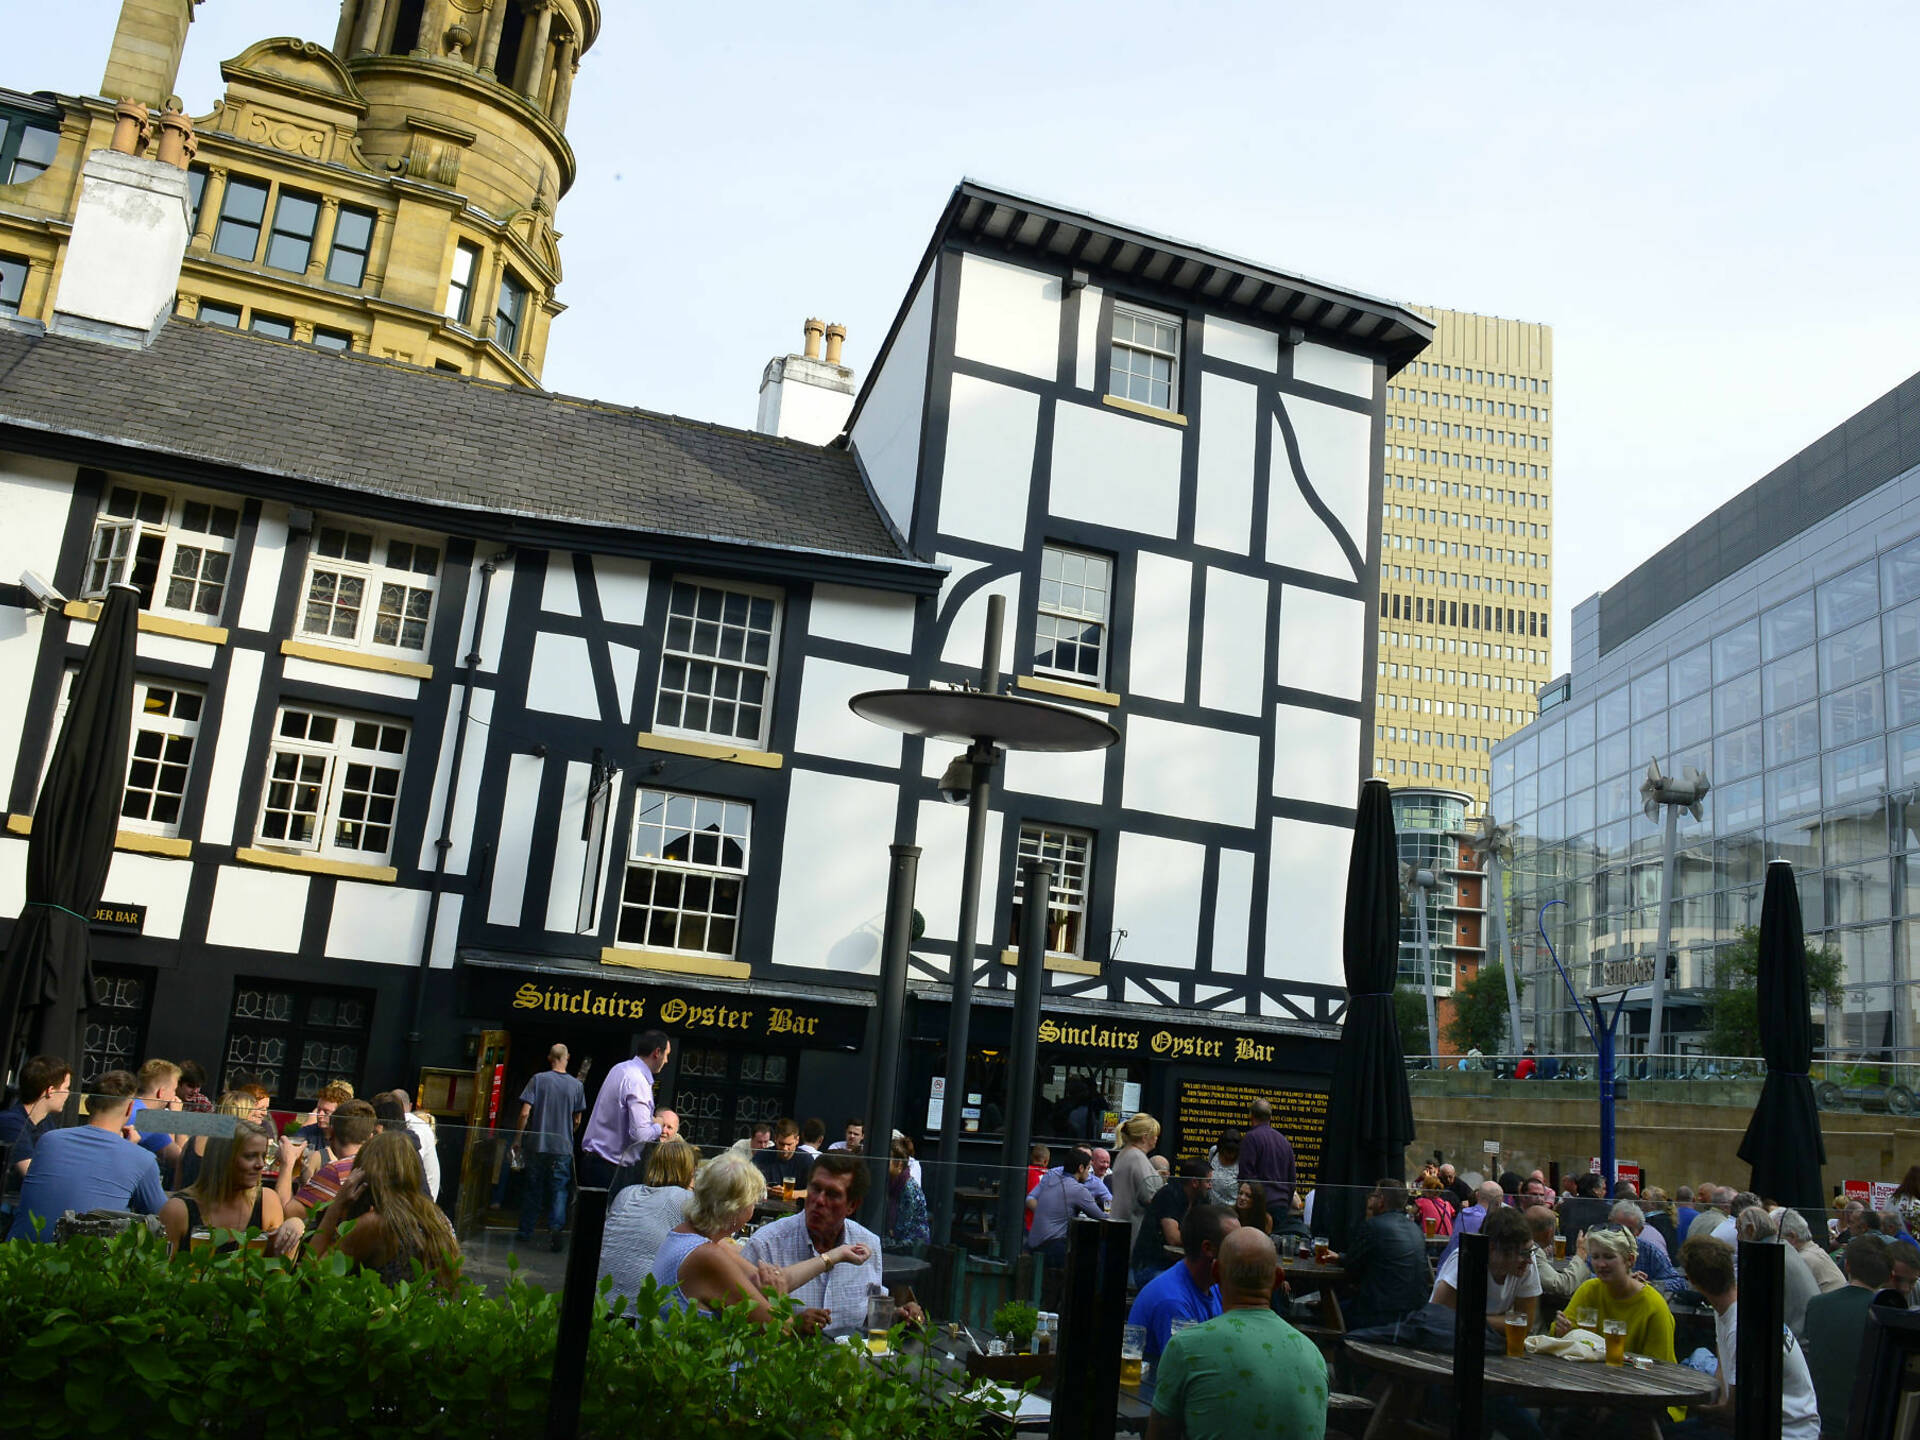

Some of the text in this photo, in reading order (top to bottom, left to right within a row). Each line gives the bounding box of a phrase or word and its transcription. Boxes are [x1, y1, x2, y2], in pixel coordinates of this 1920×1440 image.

[115, 911, 138, 924] BAR
[512, 982, 819, 1035] Sinclairs Oyster Bar
[1038, 1018, 1275, 1062] Sinclairs Oyster Bar
